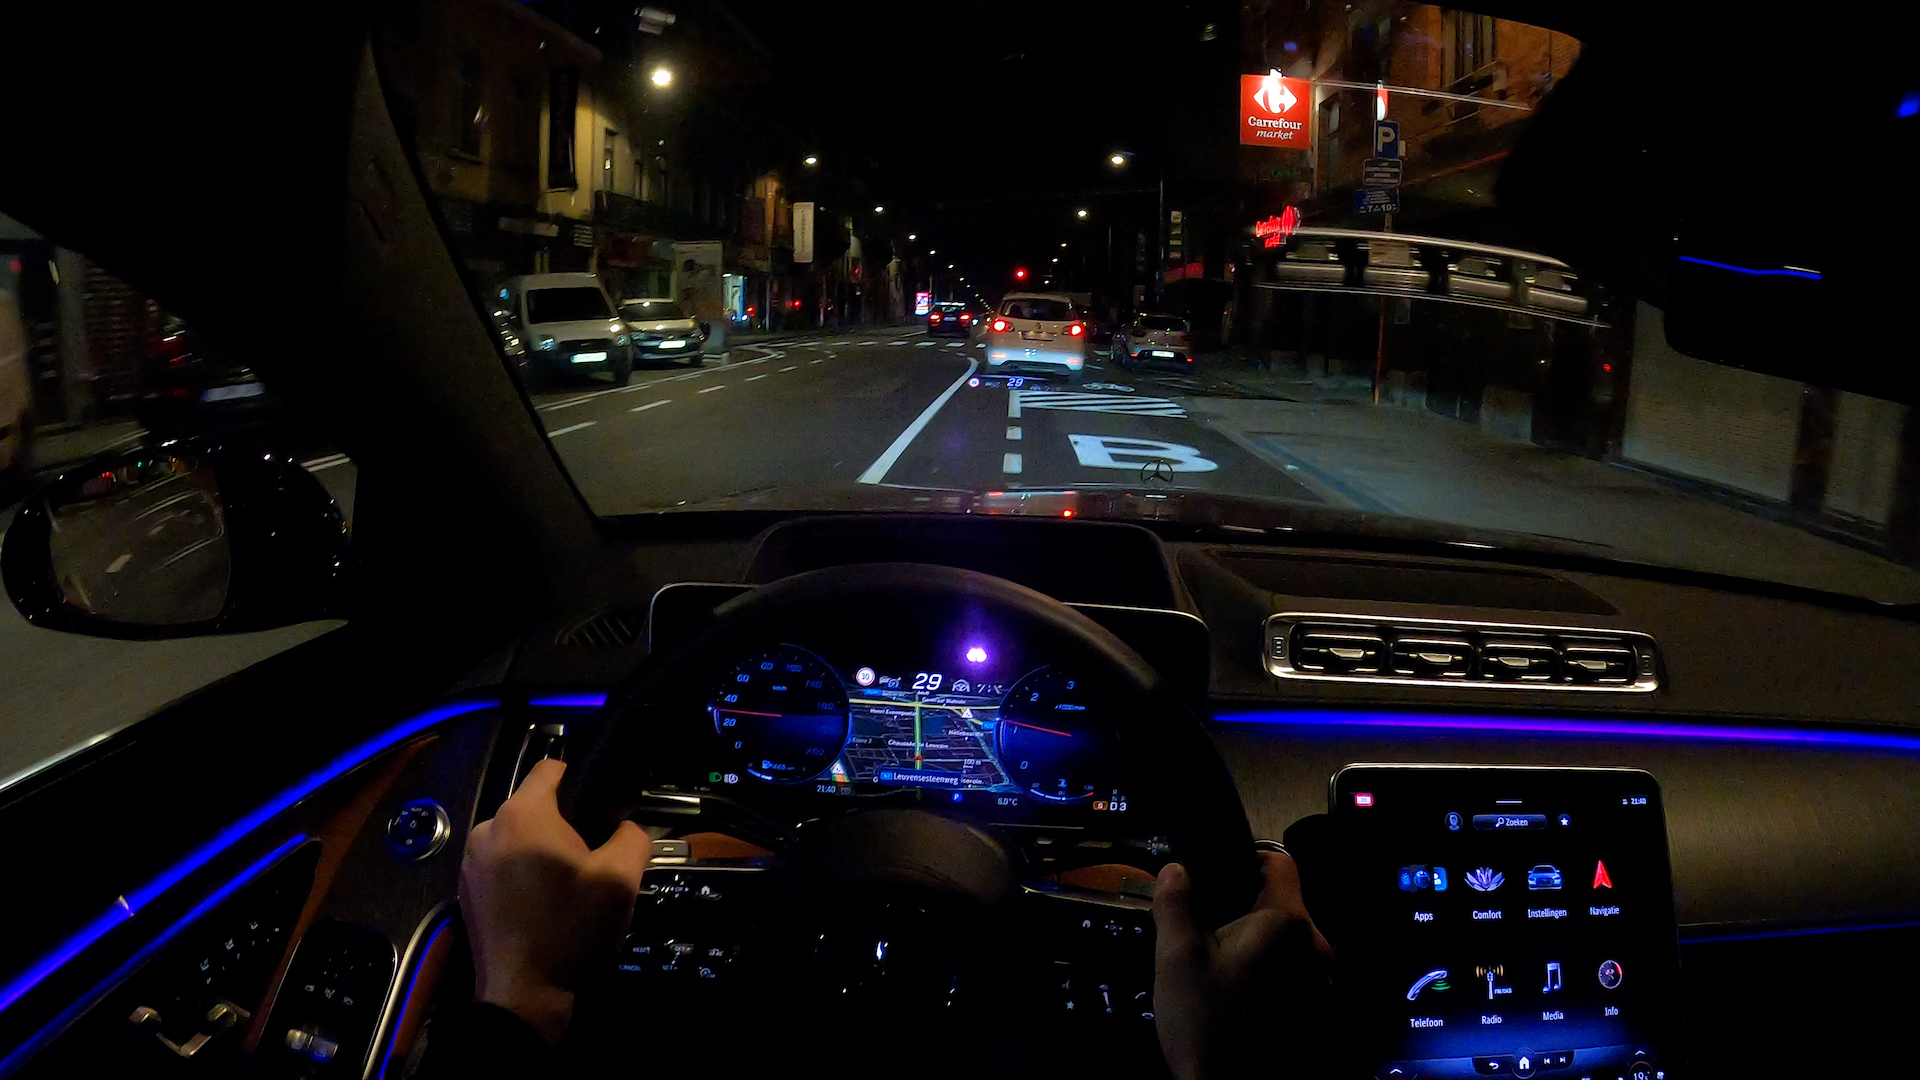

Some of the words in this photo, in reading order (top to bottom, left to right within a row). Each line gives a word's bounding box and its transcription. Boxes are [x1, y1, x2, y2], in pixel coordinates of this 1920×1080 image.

[1248, 116, 1302, 130] Carrefour
[1256, 129, 1294, 140] market
[1378, 126, 1395, 153] P
[1006, 377, 1024, 387] 29
[1067, 434, 1220, 472] B
[912, 672, 942, 690] 29
[1066, 680, 1075, 690] 3
[724, 693, 739, 703] 40
[1030, 692, 1039, 702] 2
[722, 718, 737, 727] 20
[734, 741, 742, 750] 0
[1020, 761, 1028, 769] 0
[893, 772, 958, 785] Leuvensesteenweg
[816, 784, 836, 793] 21:40
[1505, 818, 1529, 827] Zoeken
[1414, 911, 1434, 922] Apps
[1472, 910, 1502, 920] Comfort
[1527, 908, 1567, 919] Instellingen
[1589, 906, 1620, 917] Navigatie
[1543, 1011, 1564, 1021] Media
[1604, 1007, 1619, 1017] Info
[1410, 1018, 1444, 1028] Telefoon
[1481, 1015, 1502, 1025] Radio
